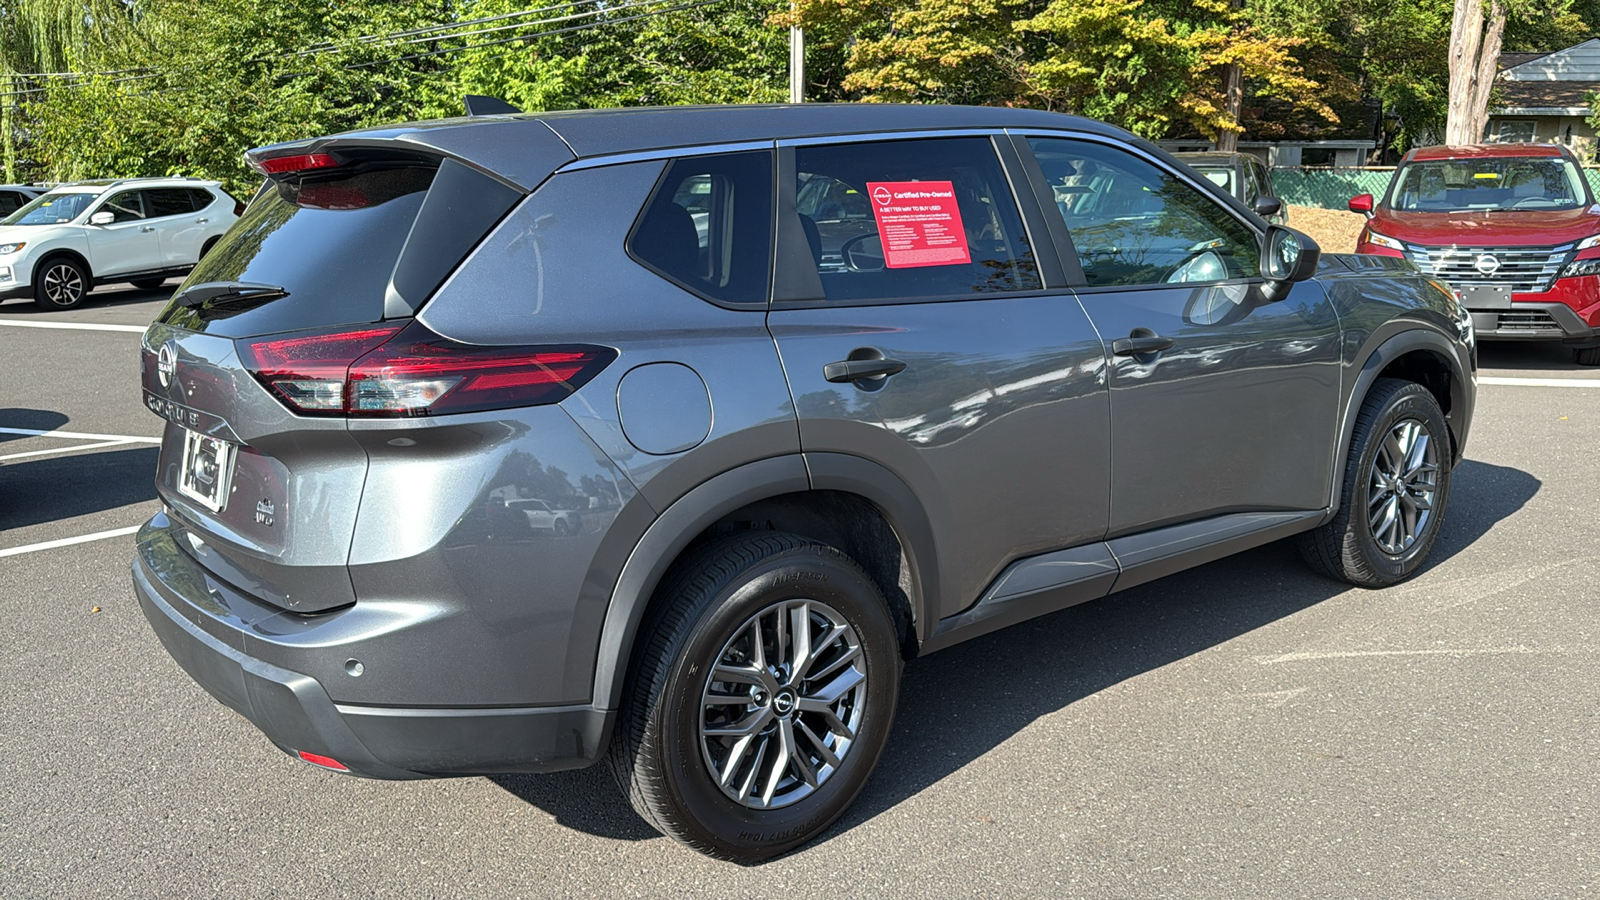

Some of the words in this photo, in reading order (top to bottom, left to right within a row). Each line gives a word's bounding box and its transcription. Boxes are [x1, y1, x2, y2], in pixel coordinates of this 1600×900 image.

[894, 191, 919, 199] Certified
[920, 190, 952, 198] Pre-Owned
[768, 829, 790, 840] R17
